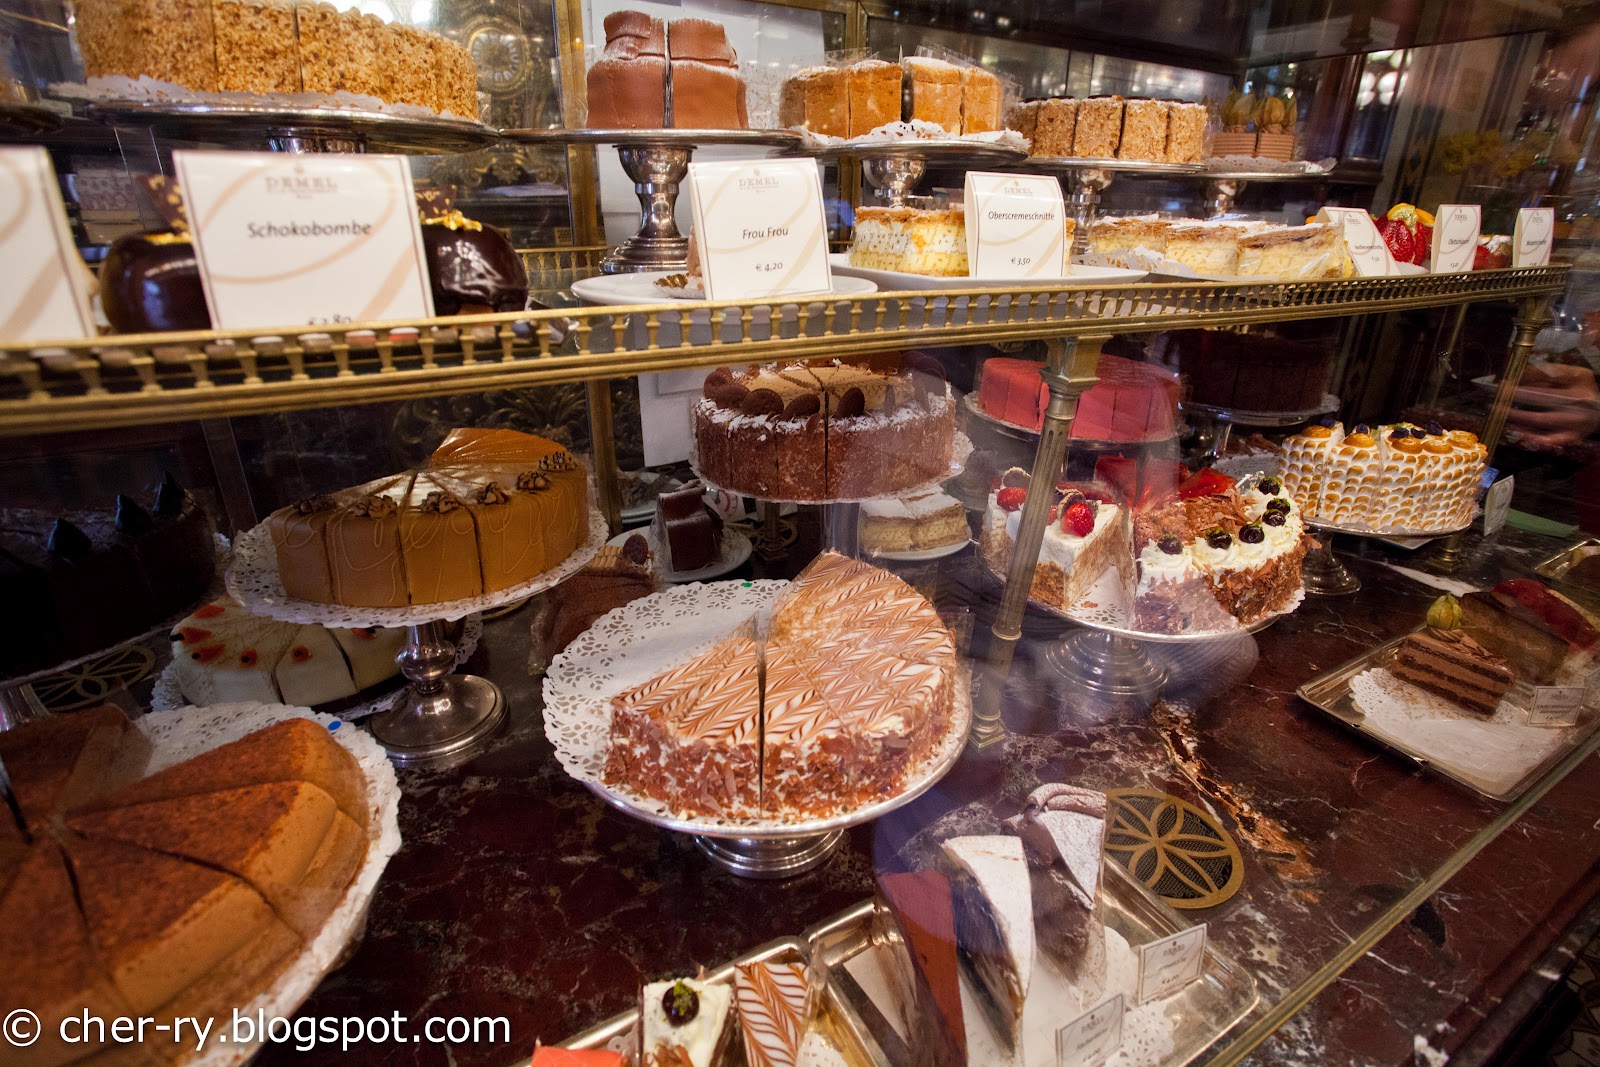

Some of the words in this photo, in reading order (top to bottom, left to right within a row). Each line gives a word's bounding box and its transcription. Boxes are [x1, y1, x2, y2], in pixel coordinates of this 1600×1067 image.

[988, 211, 1055, 221] Oberscremeschnitte
[247, 220, 371, 238] Schokobombe
[742, 228, 764, 240] Frou
[767, 227, 789, 238] Frou
[1017, 257, 1031, 266] 3,50
[755, 263, 763, 271] €
[764, 262, 783, 272] 4,20
